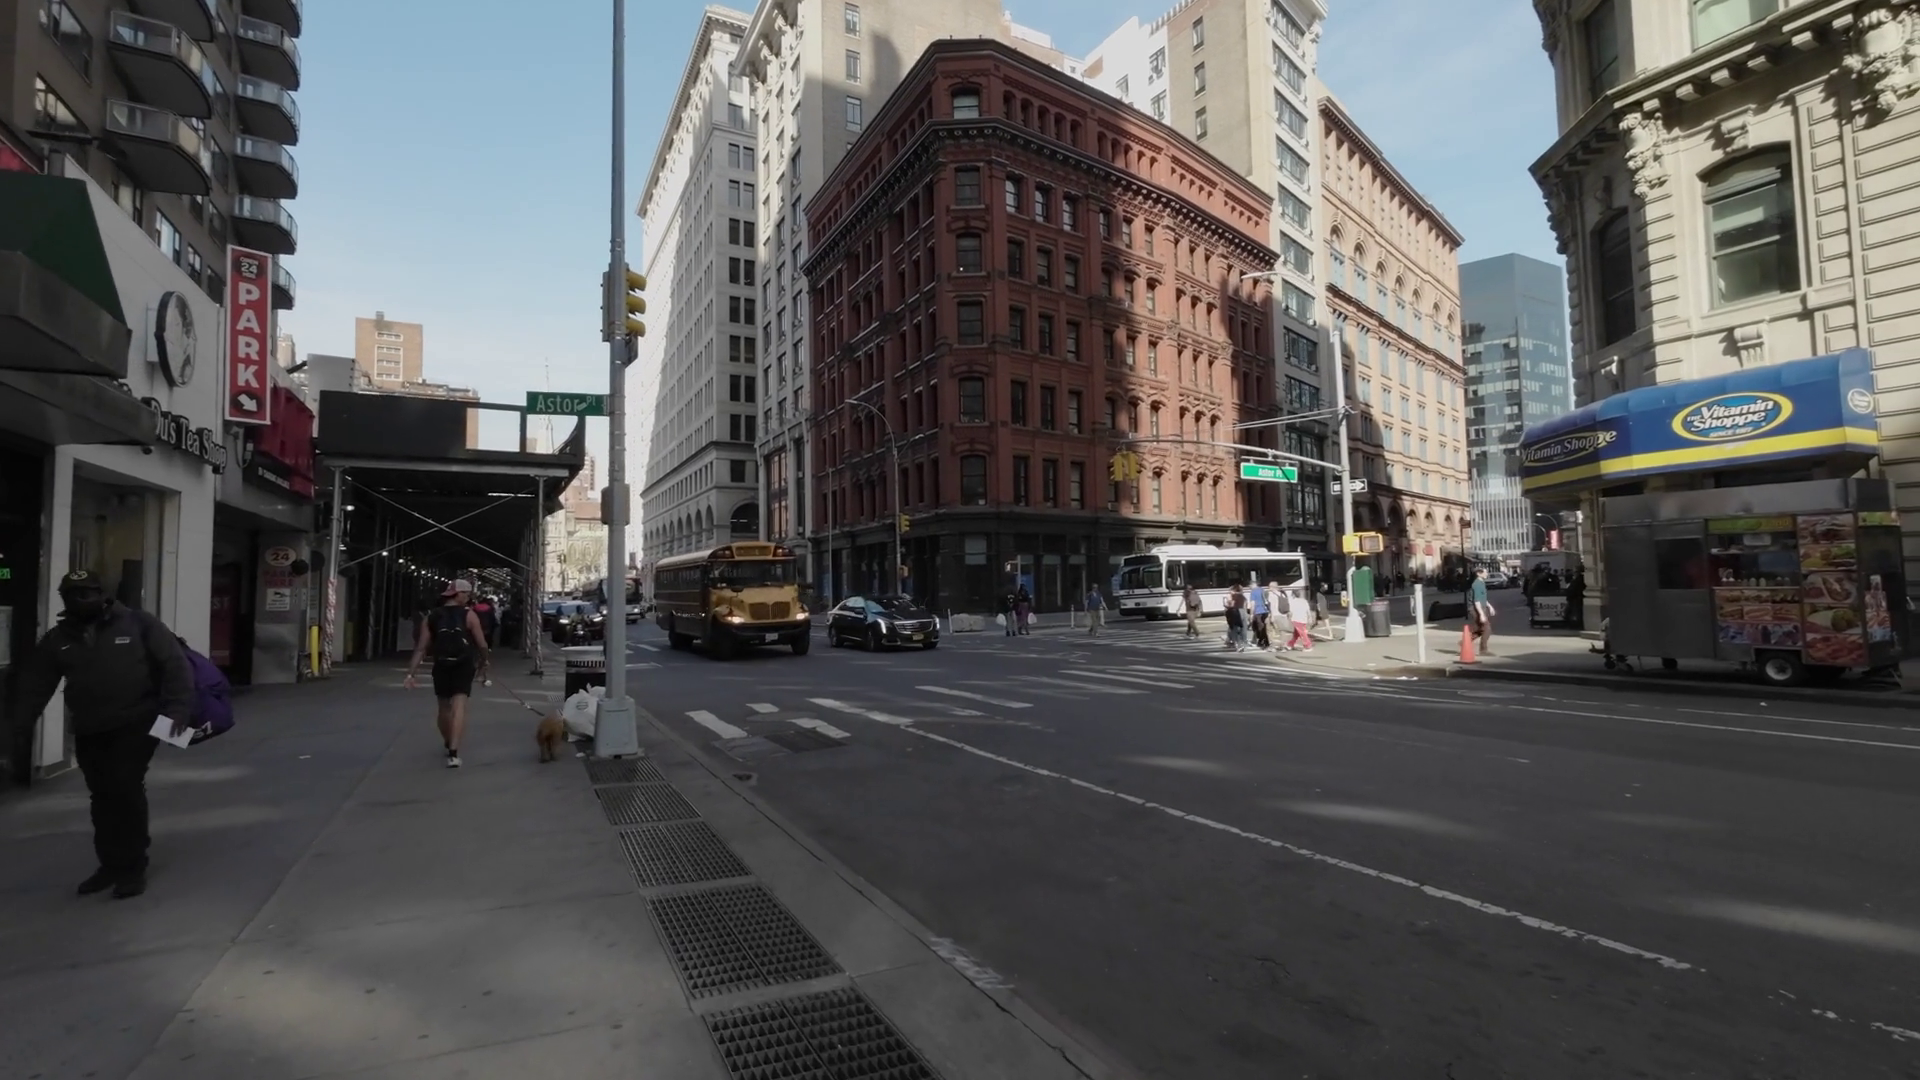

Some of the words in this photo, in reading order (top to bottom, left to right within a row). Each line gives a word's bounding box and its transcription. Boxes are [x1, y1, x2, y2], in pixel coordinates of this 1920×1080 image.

[241, 262, 257, 274] 24
[236, 281, 261, 388] PARK
[536, 394, 580, 412] Astor
[586, 396, 596, 406] Pl
[1700, 399, 1775, 420] Vitamin
[1690, 411, 1767, 433] Shoppe
[180, 417, 200, 455] Tea
[203, 429, 227, 473] Shop
[1521, 443, 1562, 462] Vitamin
[1563, 430, 1617, 453] Shoppe
[271, 552, 290, 561] 24
